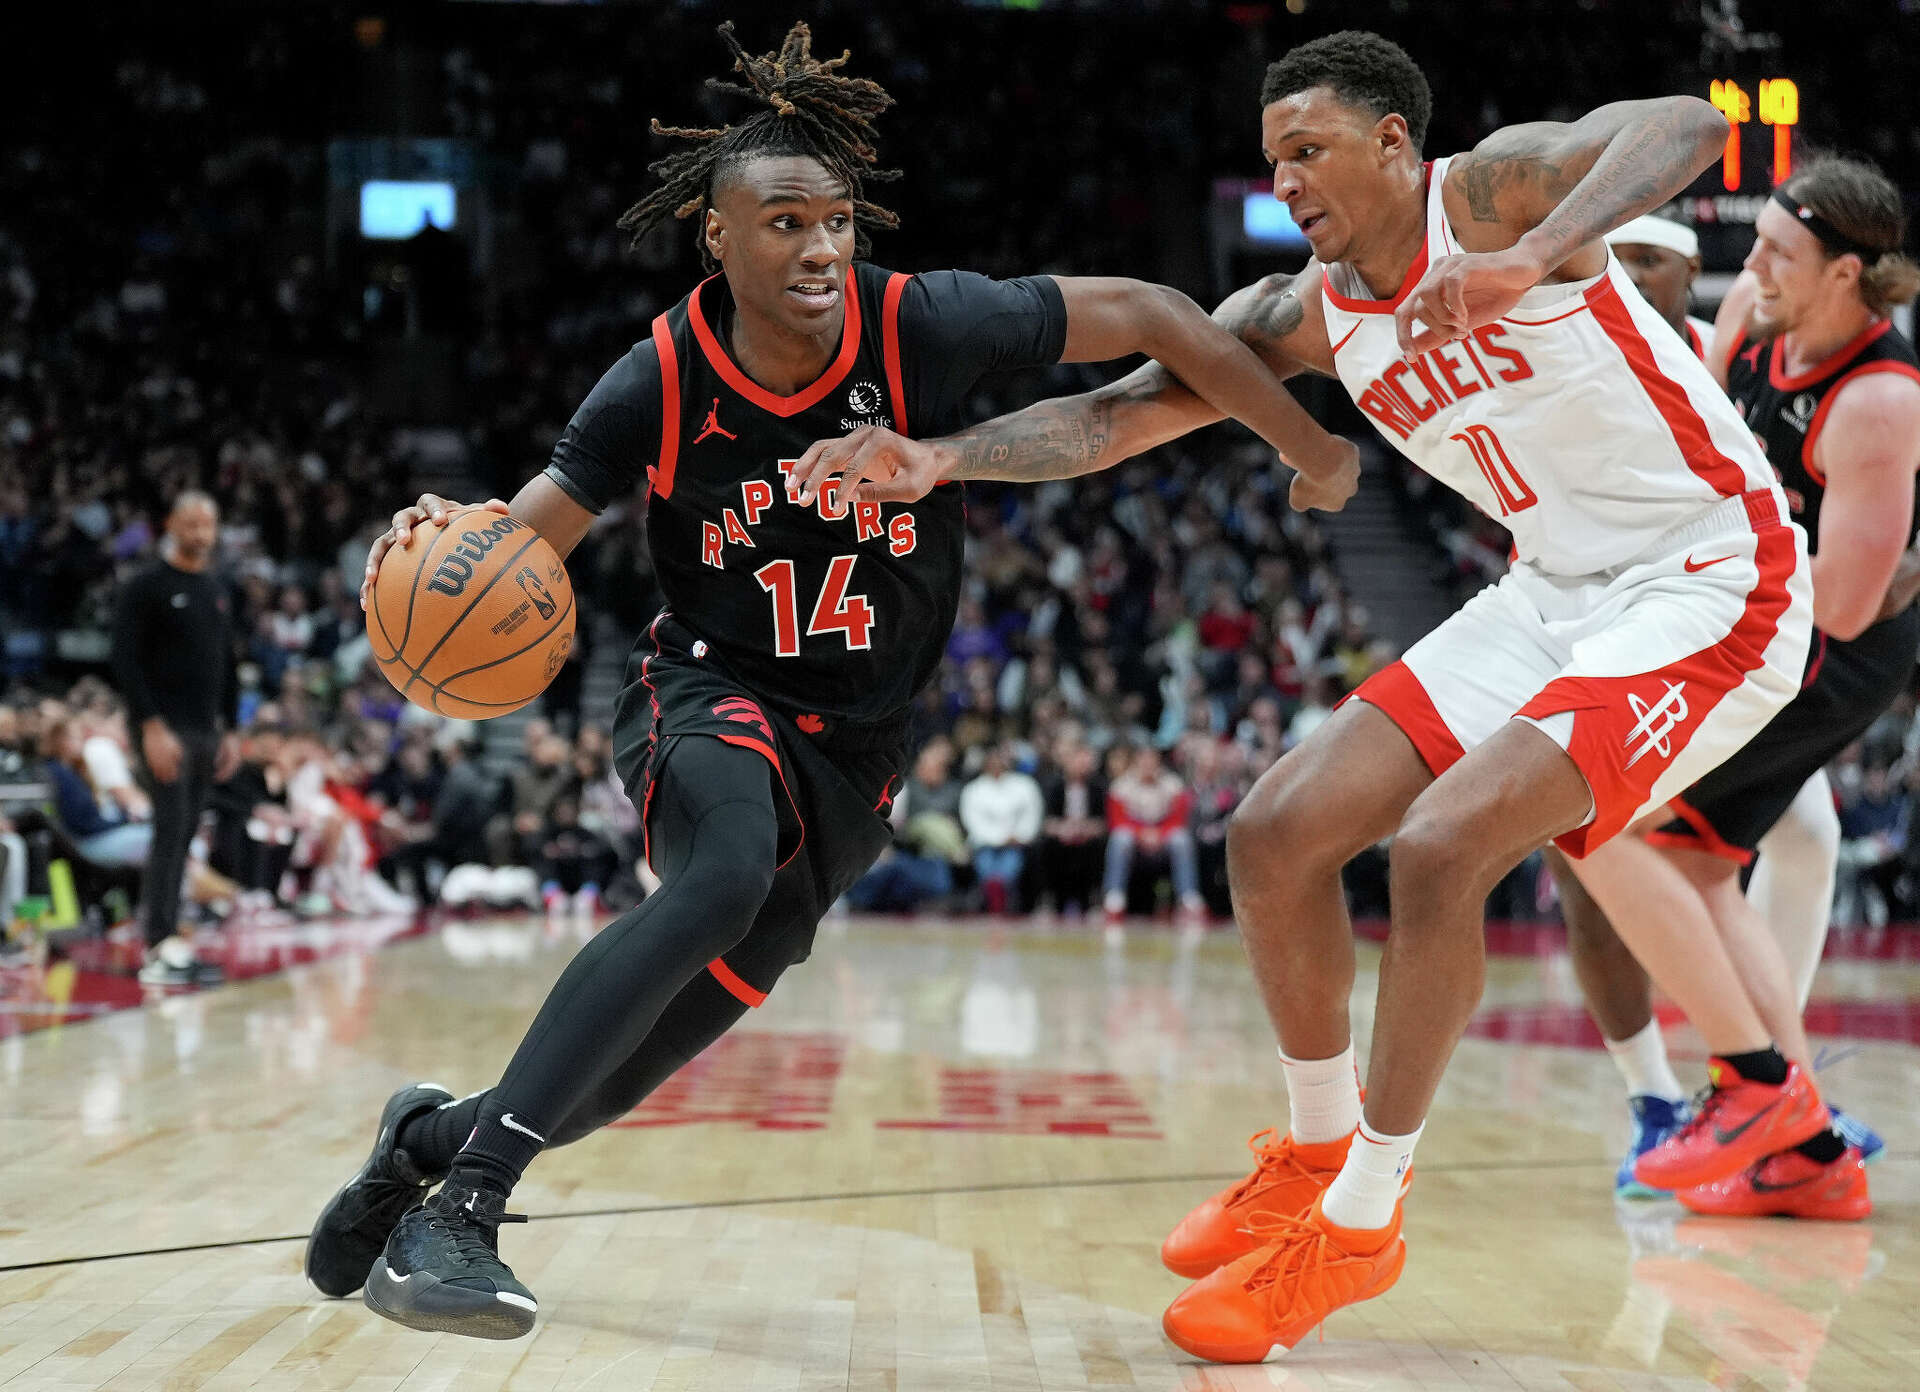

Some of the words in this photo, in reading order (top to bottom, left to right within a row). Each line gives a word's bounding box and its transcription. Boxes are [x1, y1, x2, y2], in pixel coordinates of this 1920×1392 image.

[1450, 424, 1538, 517] 10
[425, 516, 528, 597] Wilson
[753, 554, 875, 657] 14
